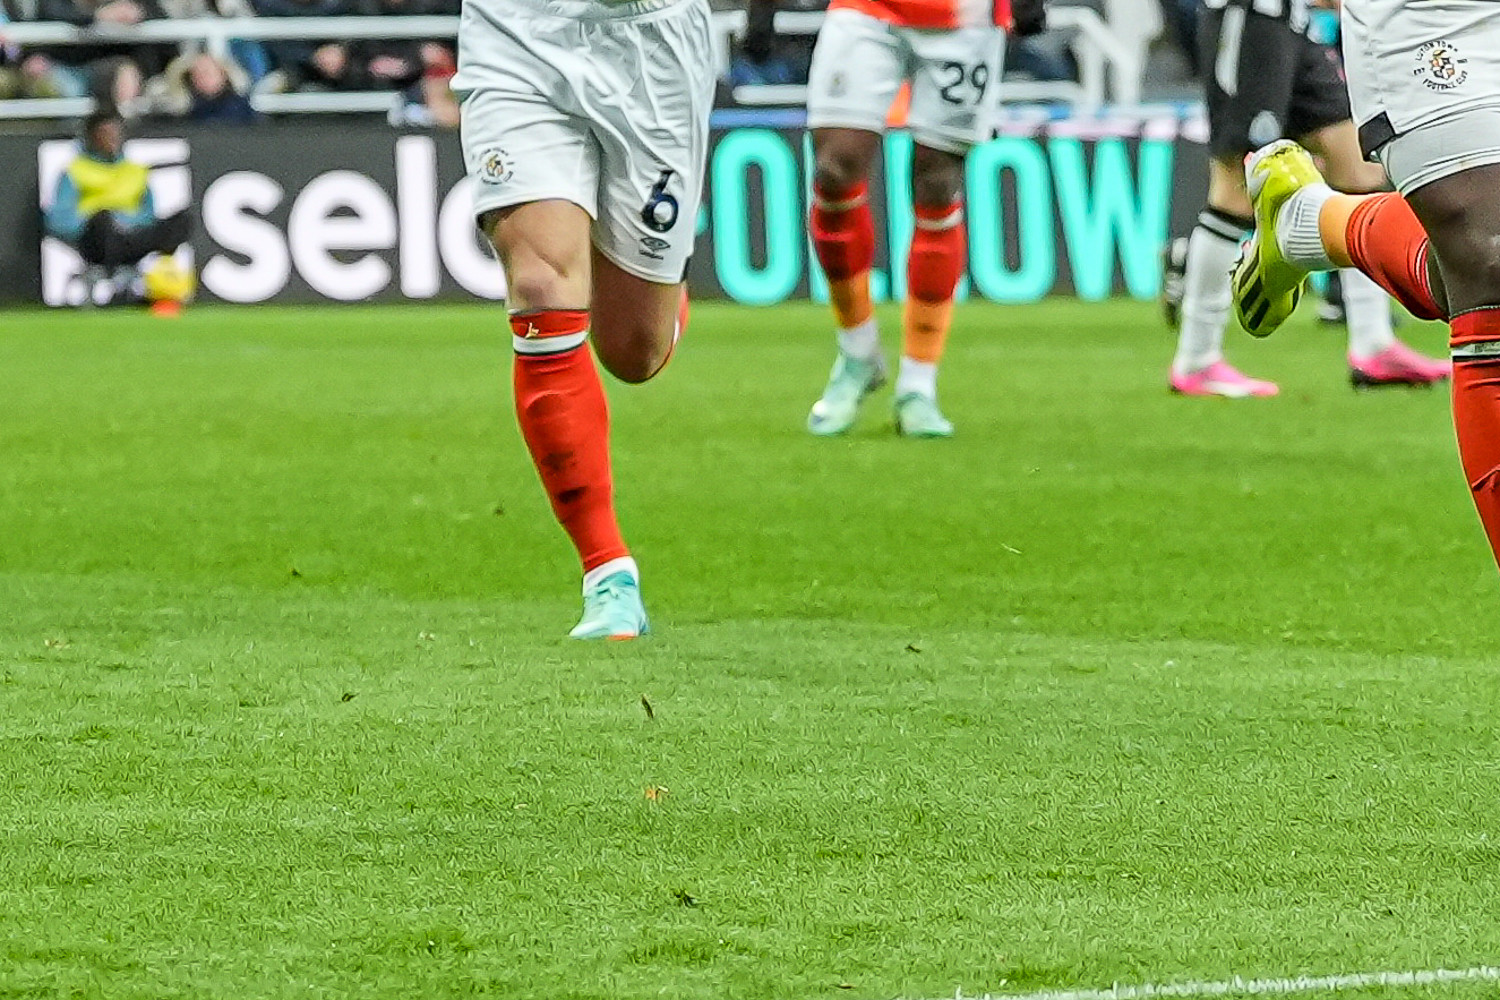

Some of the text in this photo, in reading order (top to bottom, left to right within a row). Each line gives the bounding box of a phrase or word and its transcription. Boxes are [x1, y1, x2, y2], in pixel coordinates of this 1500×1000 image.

[940, 62, 988, 105] 29
[641, 169, 679, 233] 6
[696, 127, 1174, 306] OLOW
